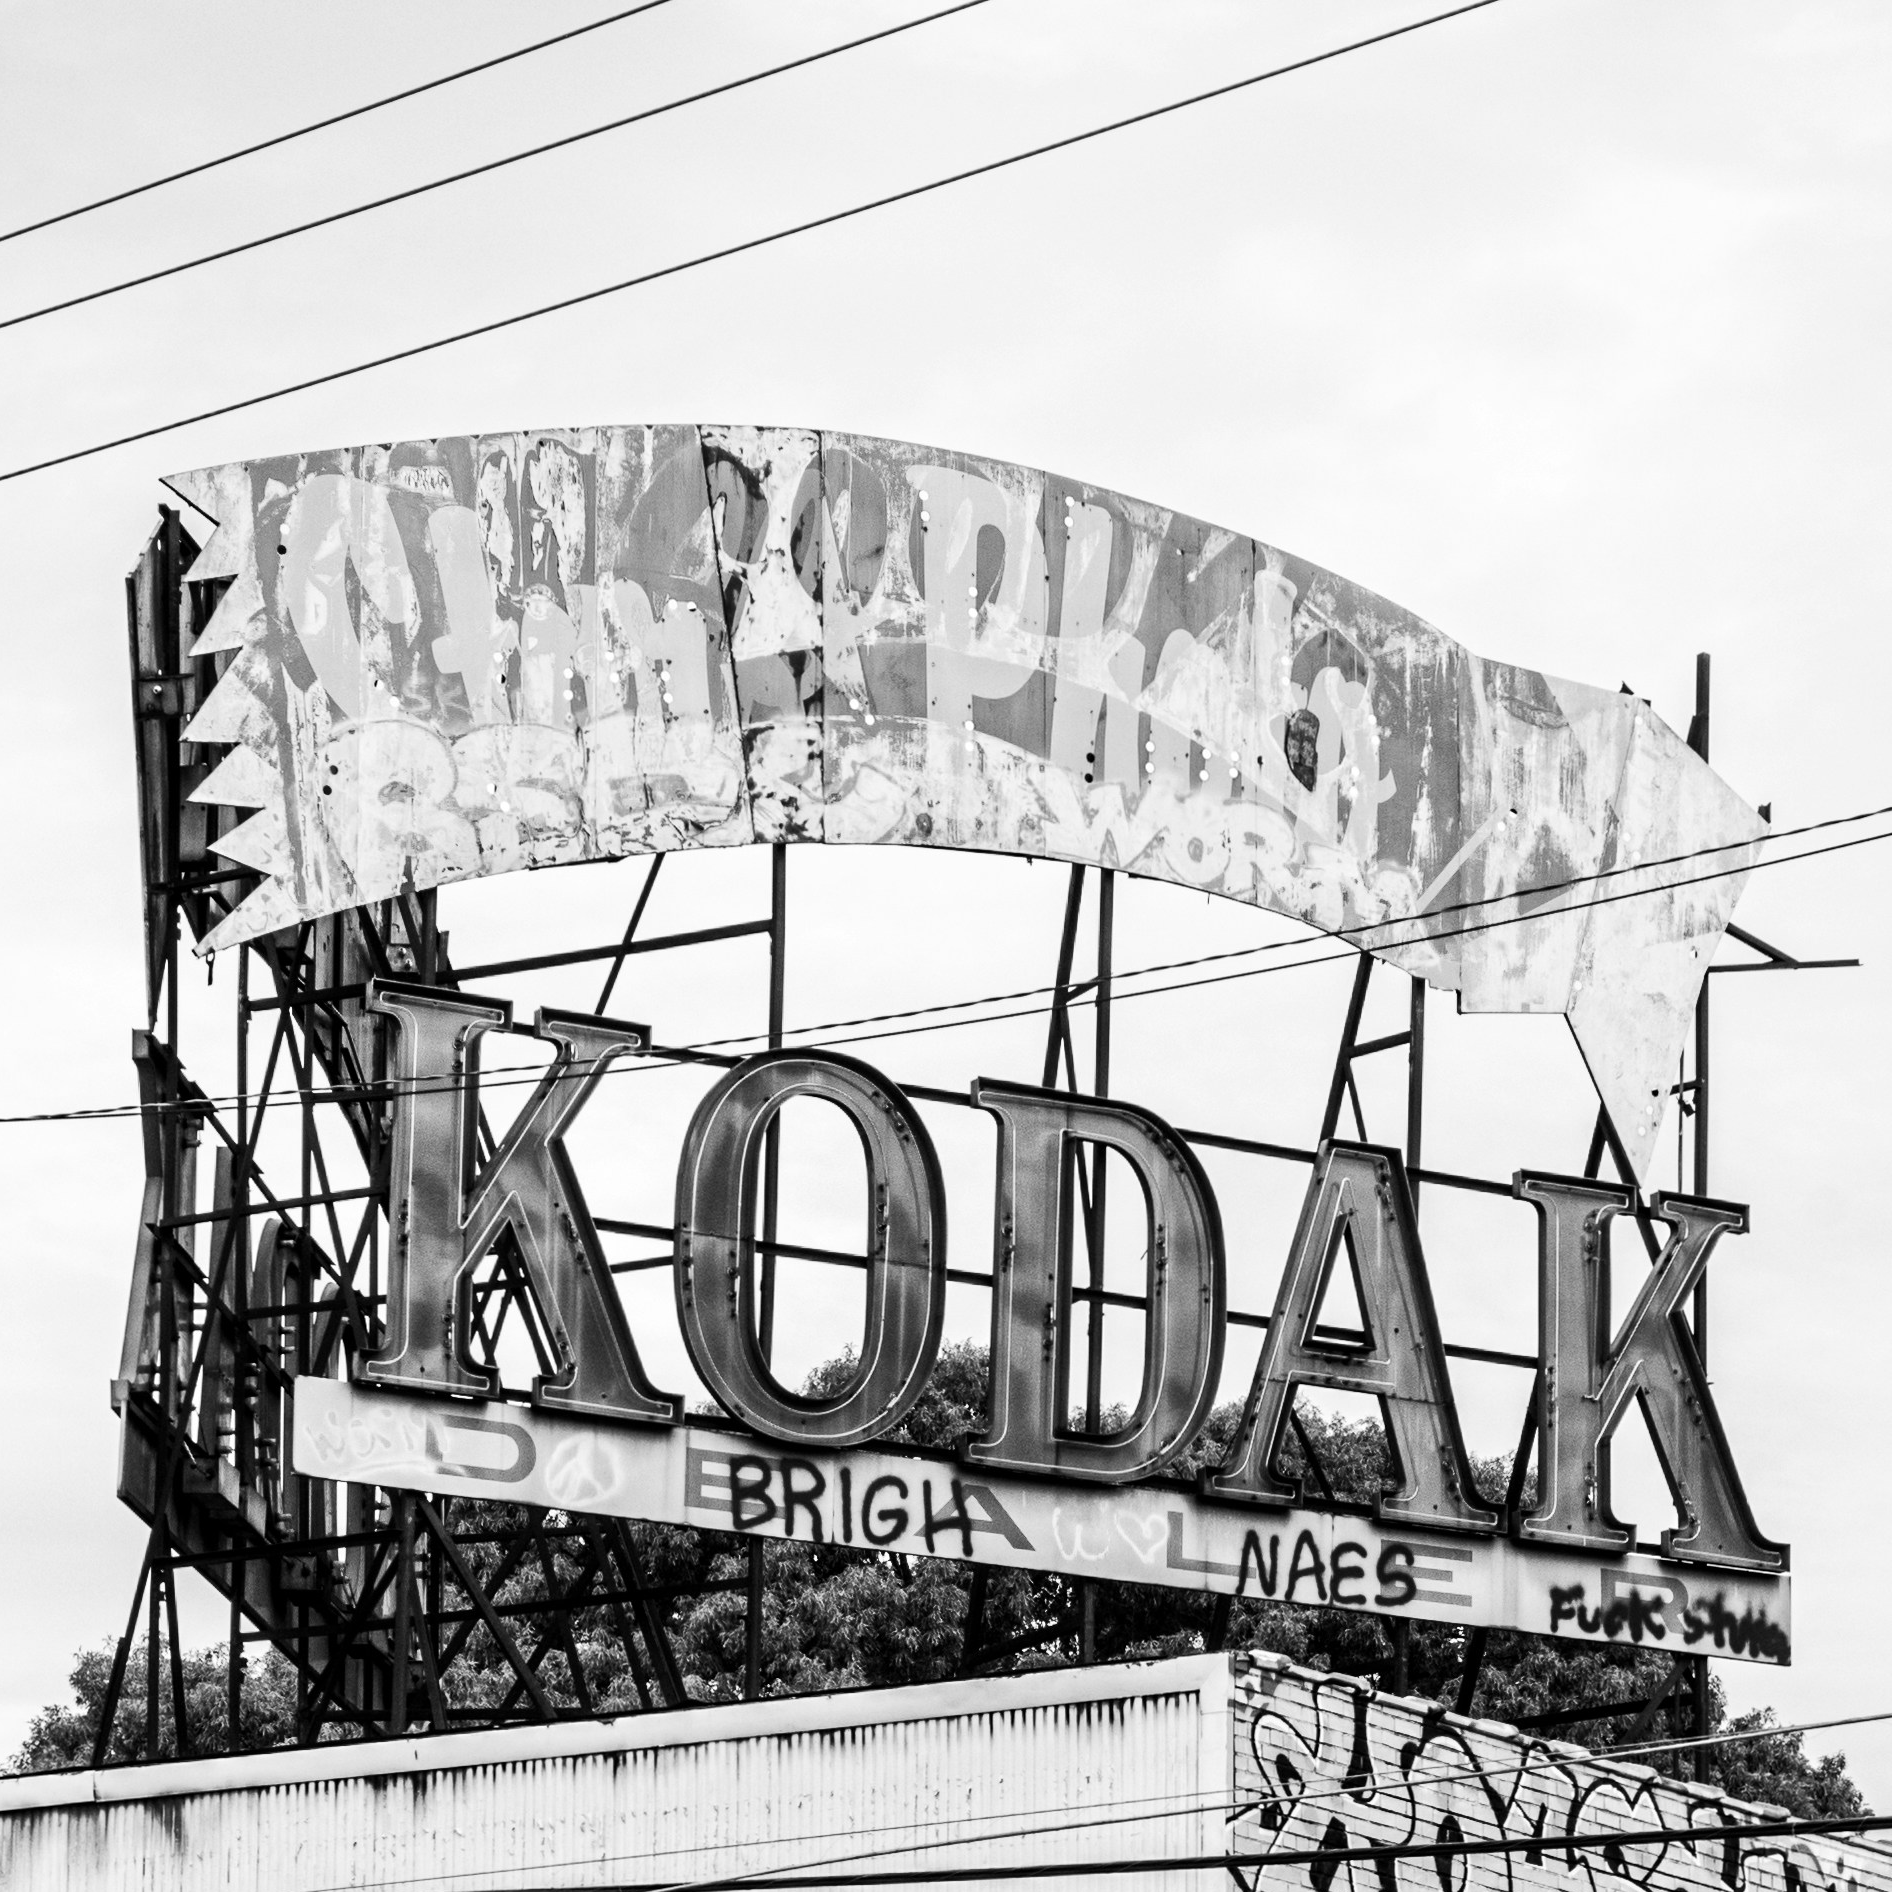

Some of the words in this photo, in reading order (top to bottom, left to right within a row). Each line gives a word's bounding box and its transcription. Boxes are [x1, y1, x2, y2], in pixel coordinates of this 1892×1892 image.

[351, 977, 1791, 1574] KODAK
[729, 1455, 974, 1557] BRIGH
[1235, 1529, 1418, 1607] NAES
